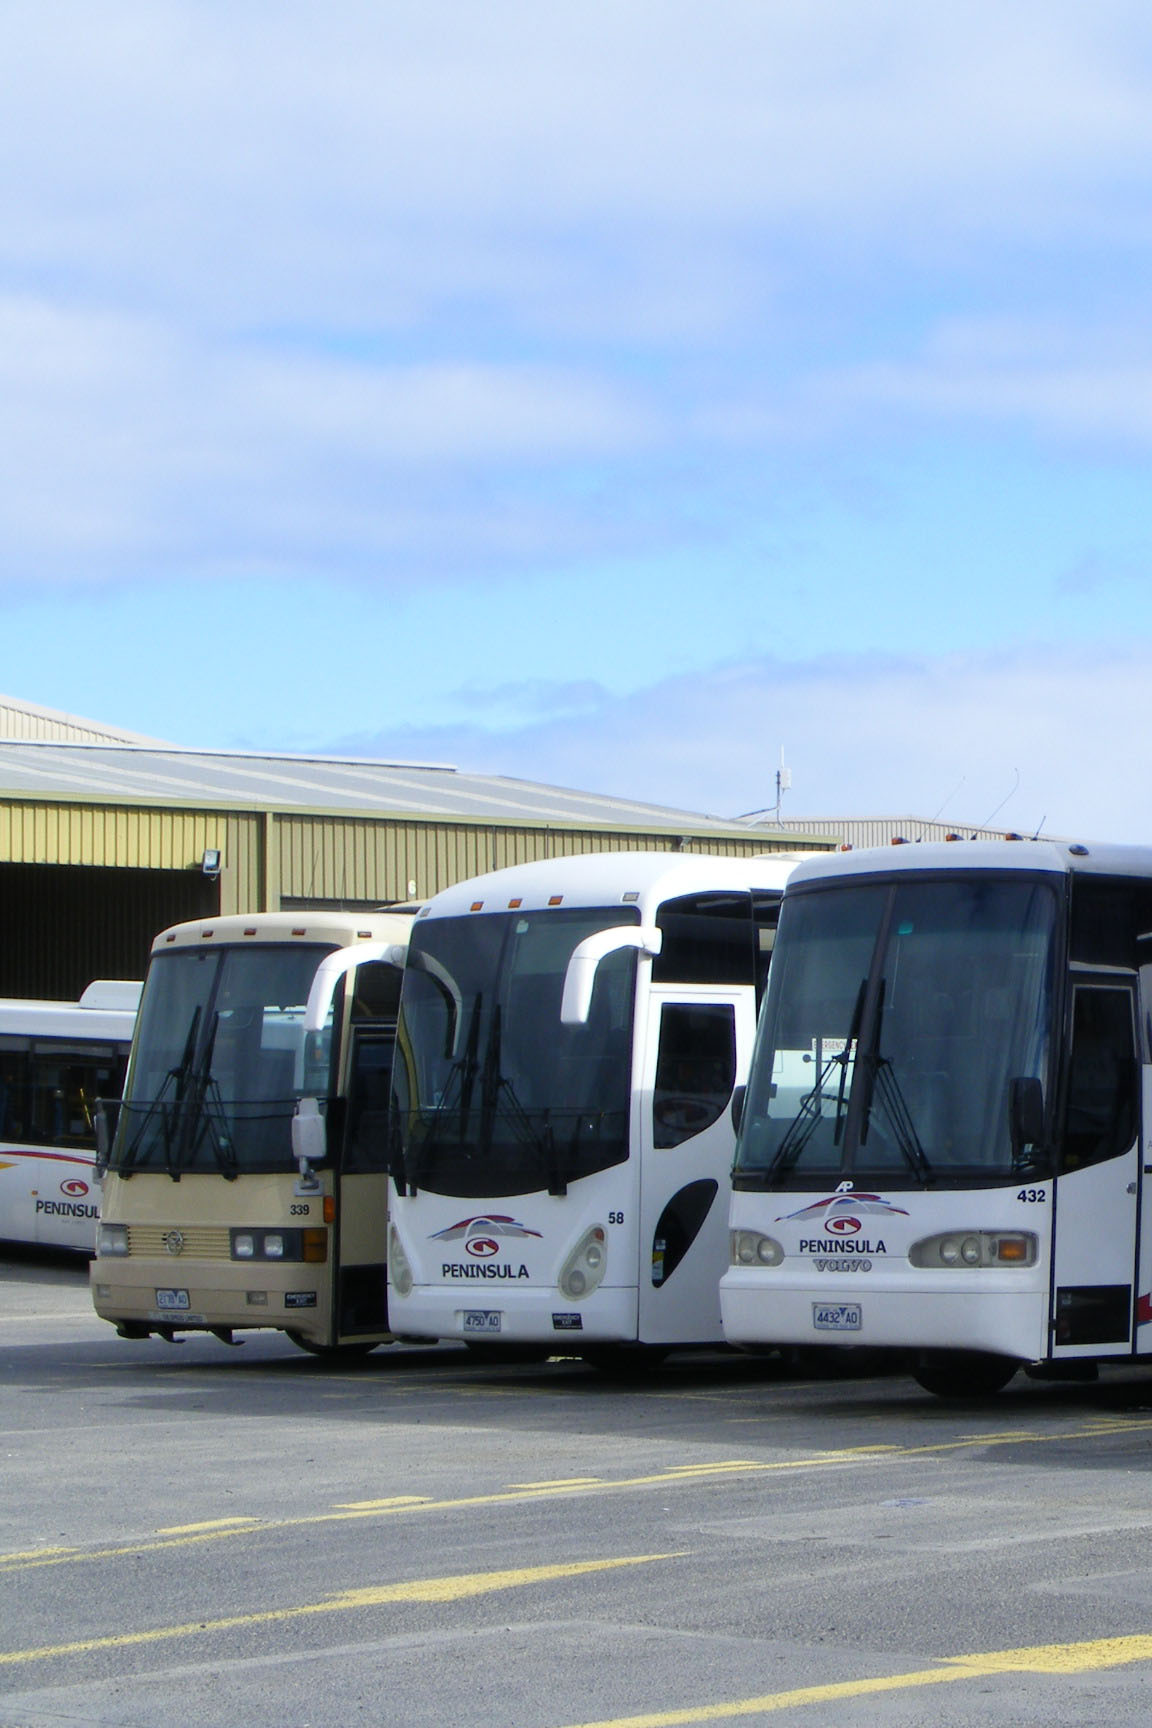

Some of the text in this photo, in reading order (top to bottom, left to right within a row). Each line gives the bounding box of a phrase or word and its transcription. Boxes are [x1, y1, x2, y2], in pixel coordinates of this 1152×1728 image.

[1017, 1189, 1046, 1203] 432
[36, 1200, 100, 1219] PENINSUL
[290, 1204, 310, 1216] 339
[608, 1212, 625, 1224] 58
[799, 1239, 887, 1254] PENINSULA
[442, 1263, 530, 1279] PENINSULA
[813, 1259, 873, 1272] VOLVO
[466, 1315, 485, 1326] 4750
[817, 1311, 858, 1324] 4432 AO
